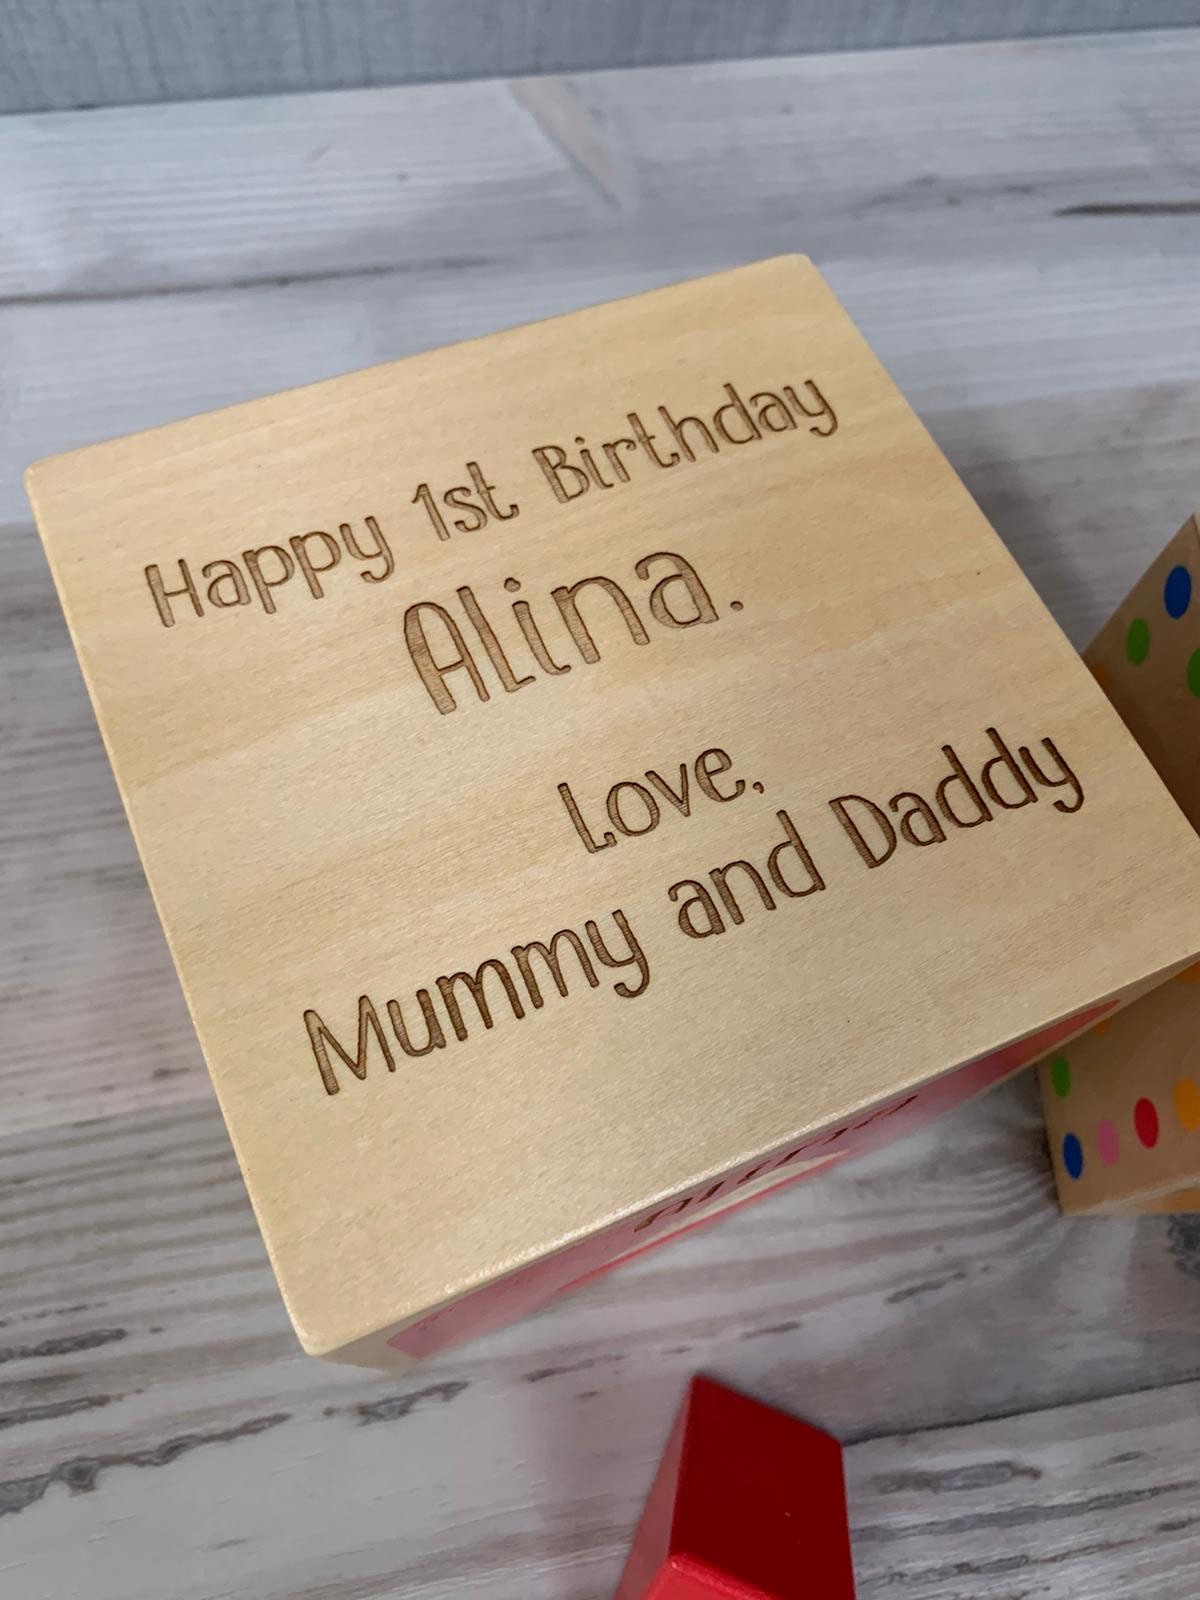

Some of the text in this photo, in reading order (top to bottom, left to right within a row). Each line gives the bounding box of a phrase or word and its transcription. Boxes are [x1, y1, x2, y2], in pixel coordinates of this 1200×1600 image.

[143, 379, 838, 629] Happy 1st Birthday
[402, 550, 744, 716] Alina.
[556, 747, 765, 855] Love,
[302, 727, 1085, 1097] Mummy and Daddy
